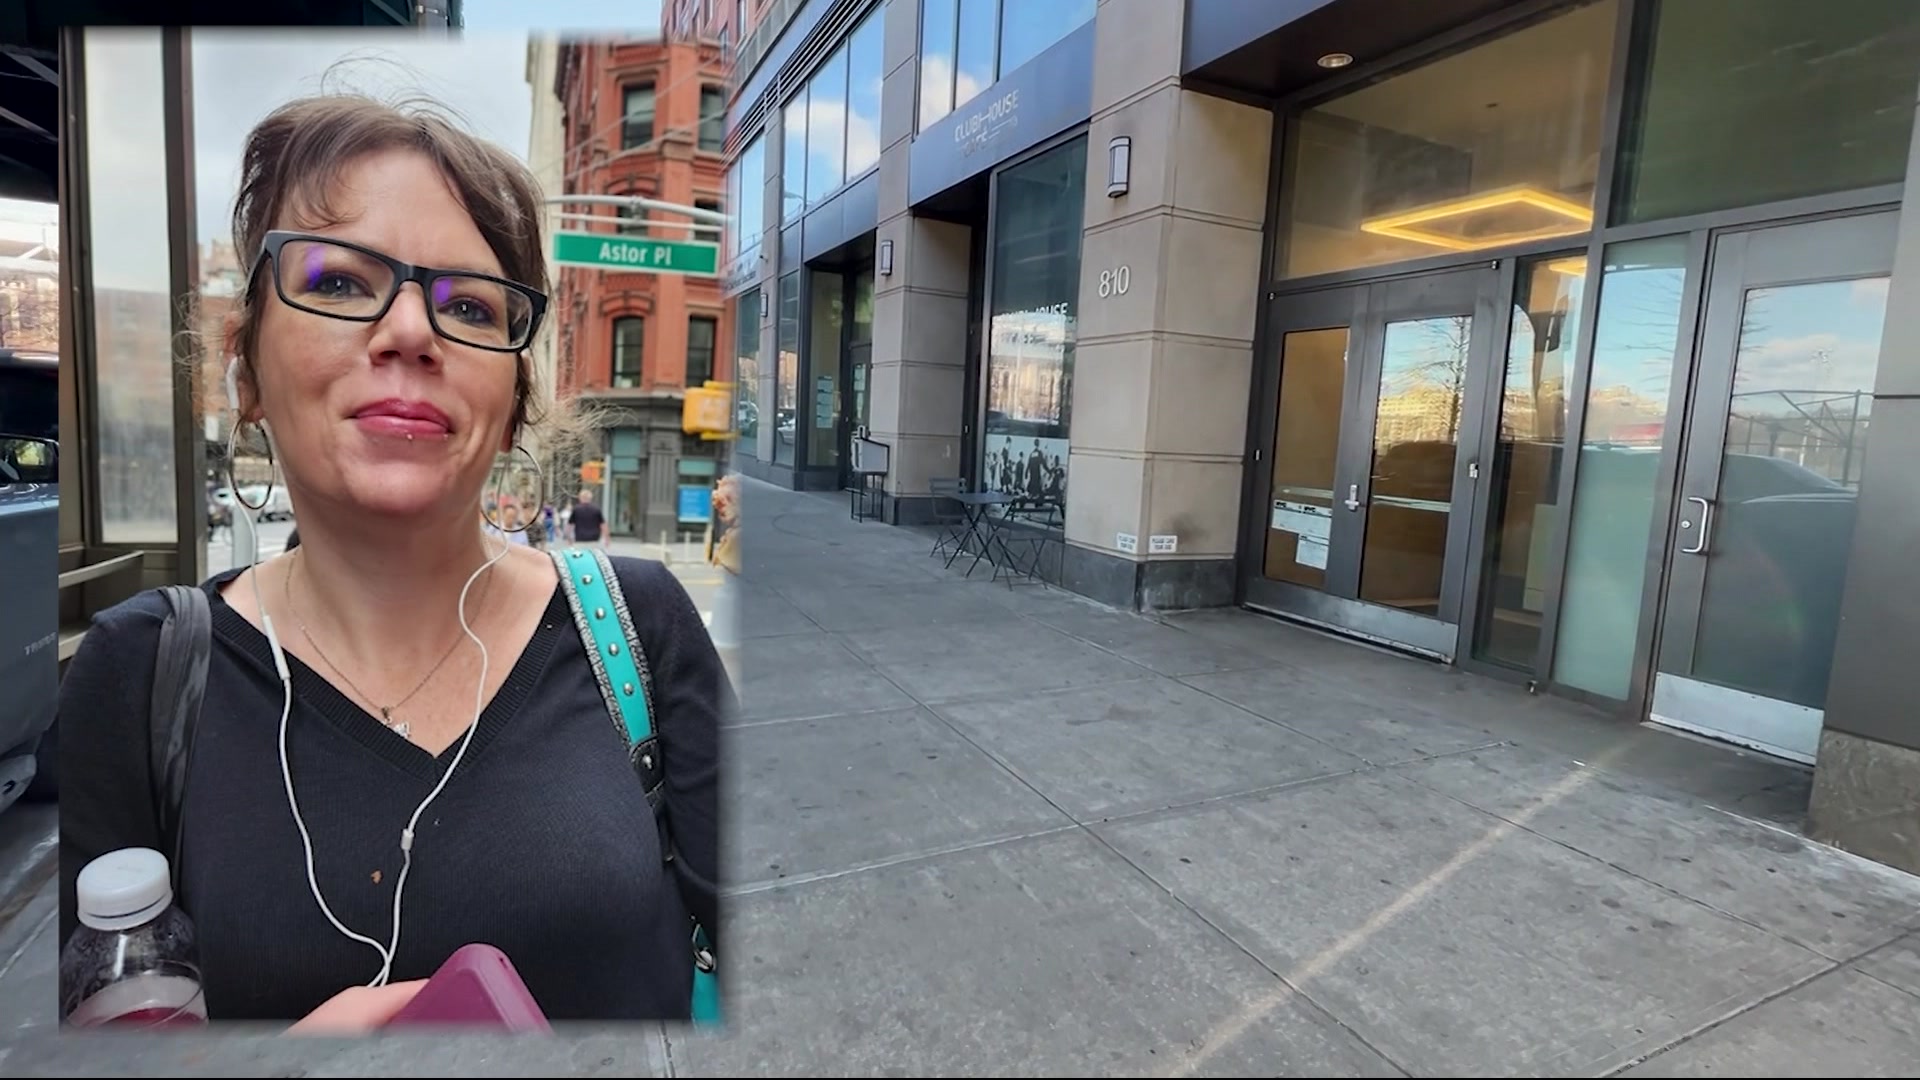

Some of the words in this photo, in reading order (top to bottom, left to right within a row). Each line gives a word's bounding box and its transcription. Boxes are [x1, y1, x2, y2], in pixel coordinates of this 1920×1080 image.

[600, 242, 647, 263] Astor
[654, 246, 672, 266] Pl
[1099, 266, 1129, 298] 810
